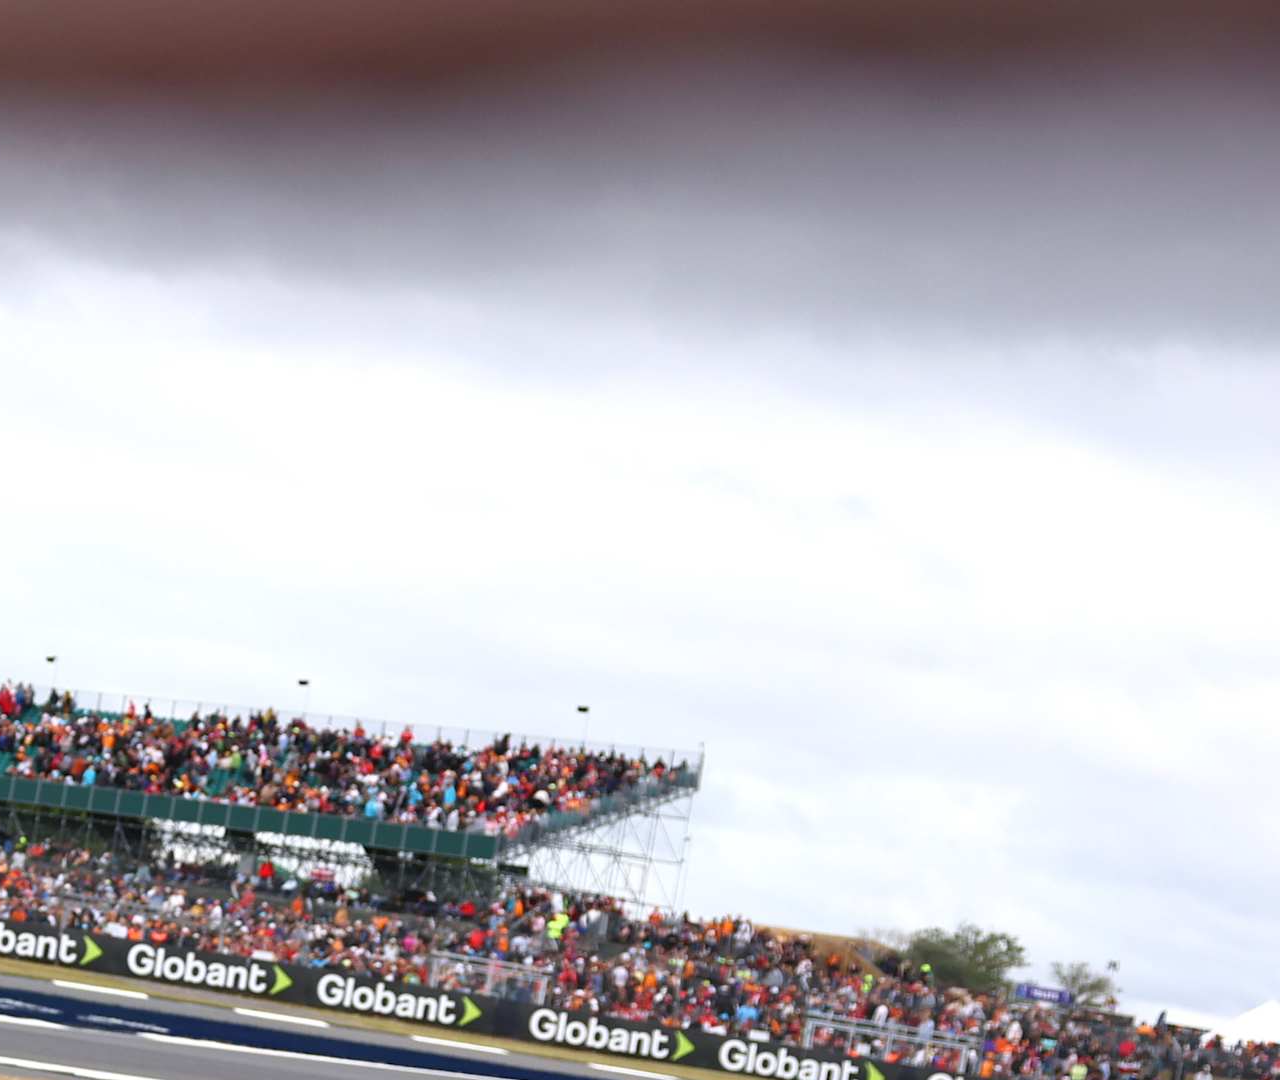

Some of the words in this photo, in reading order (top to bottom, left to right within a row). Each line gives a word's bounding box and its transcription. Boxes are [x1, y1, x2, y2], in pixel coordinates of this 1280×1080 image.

[127, 944, 267, 995] Globant
[317, 973, 456, 1026] Globant
[529, 1007, 671, 1060] Globant
